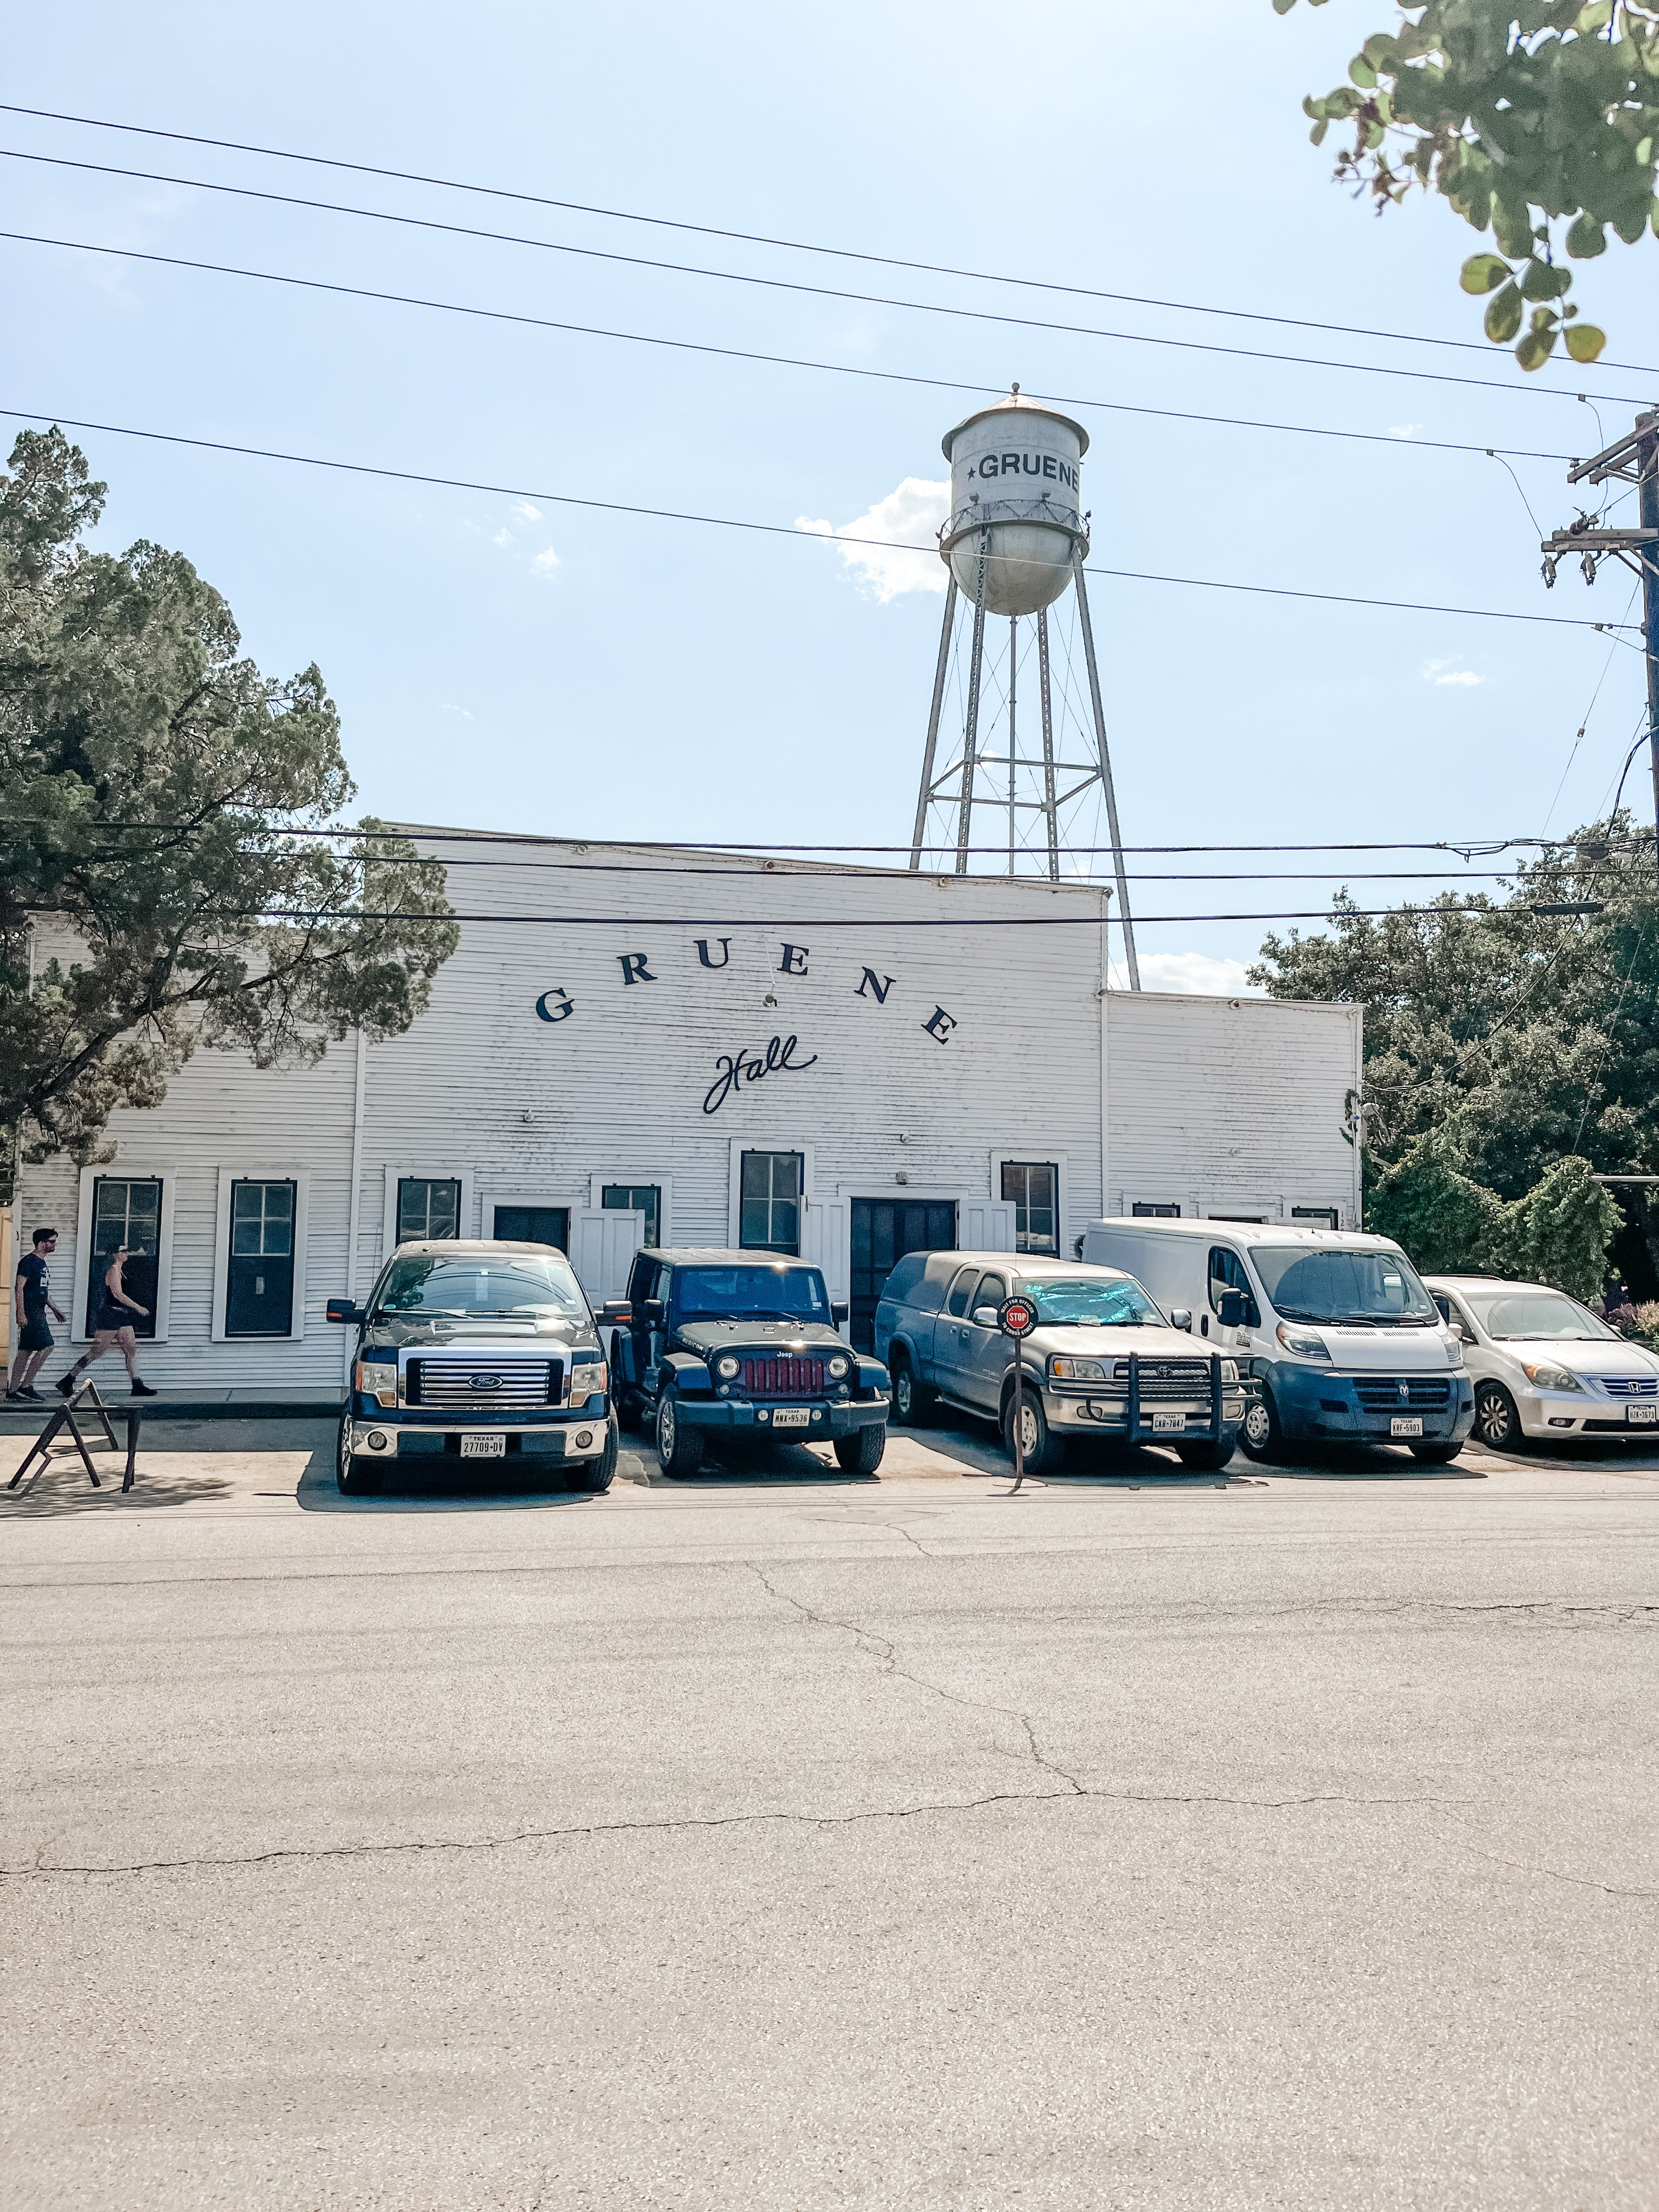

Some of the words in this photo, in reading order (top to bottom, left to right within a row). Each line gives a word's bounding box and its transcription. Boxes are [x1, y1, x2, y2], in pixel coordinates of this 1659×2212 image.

[979, 453, 1079, 494] GRUENE
[535, 937, 957, 1045] GRUENE
[703, 1035, 818, 1114] Hall
[1000, 1302, 1009, 1313] WAIT
[1019, 1299, 1035, 1313] OFFICER
[1009, 1312, 1026, 1321] STOP
[1006, 1327, 1020, 1335] CROSS
[1021, 1322, 1034, 1335] STREET
[682, 1338, 704, 1351] RUBICON
[477, 1377, 495, 1385] Ford
